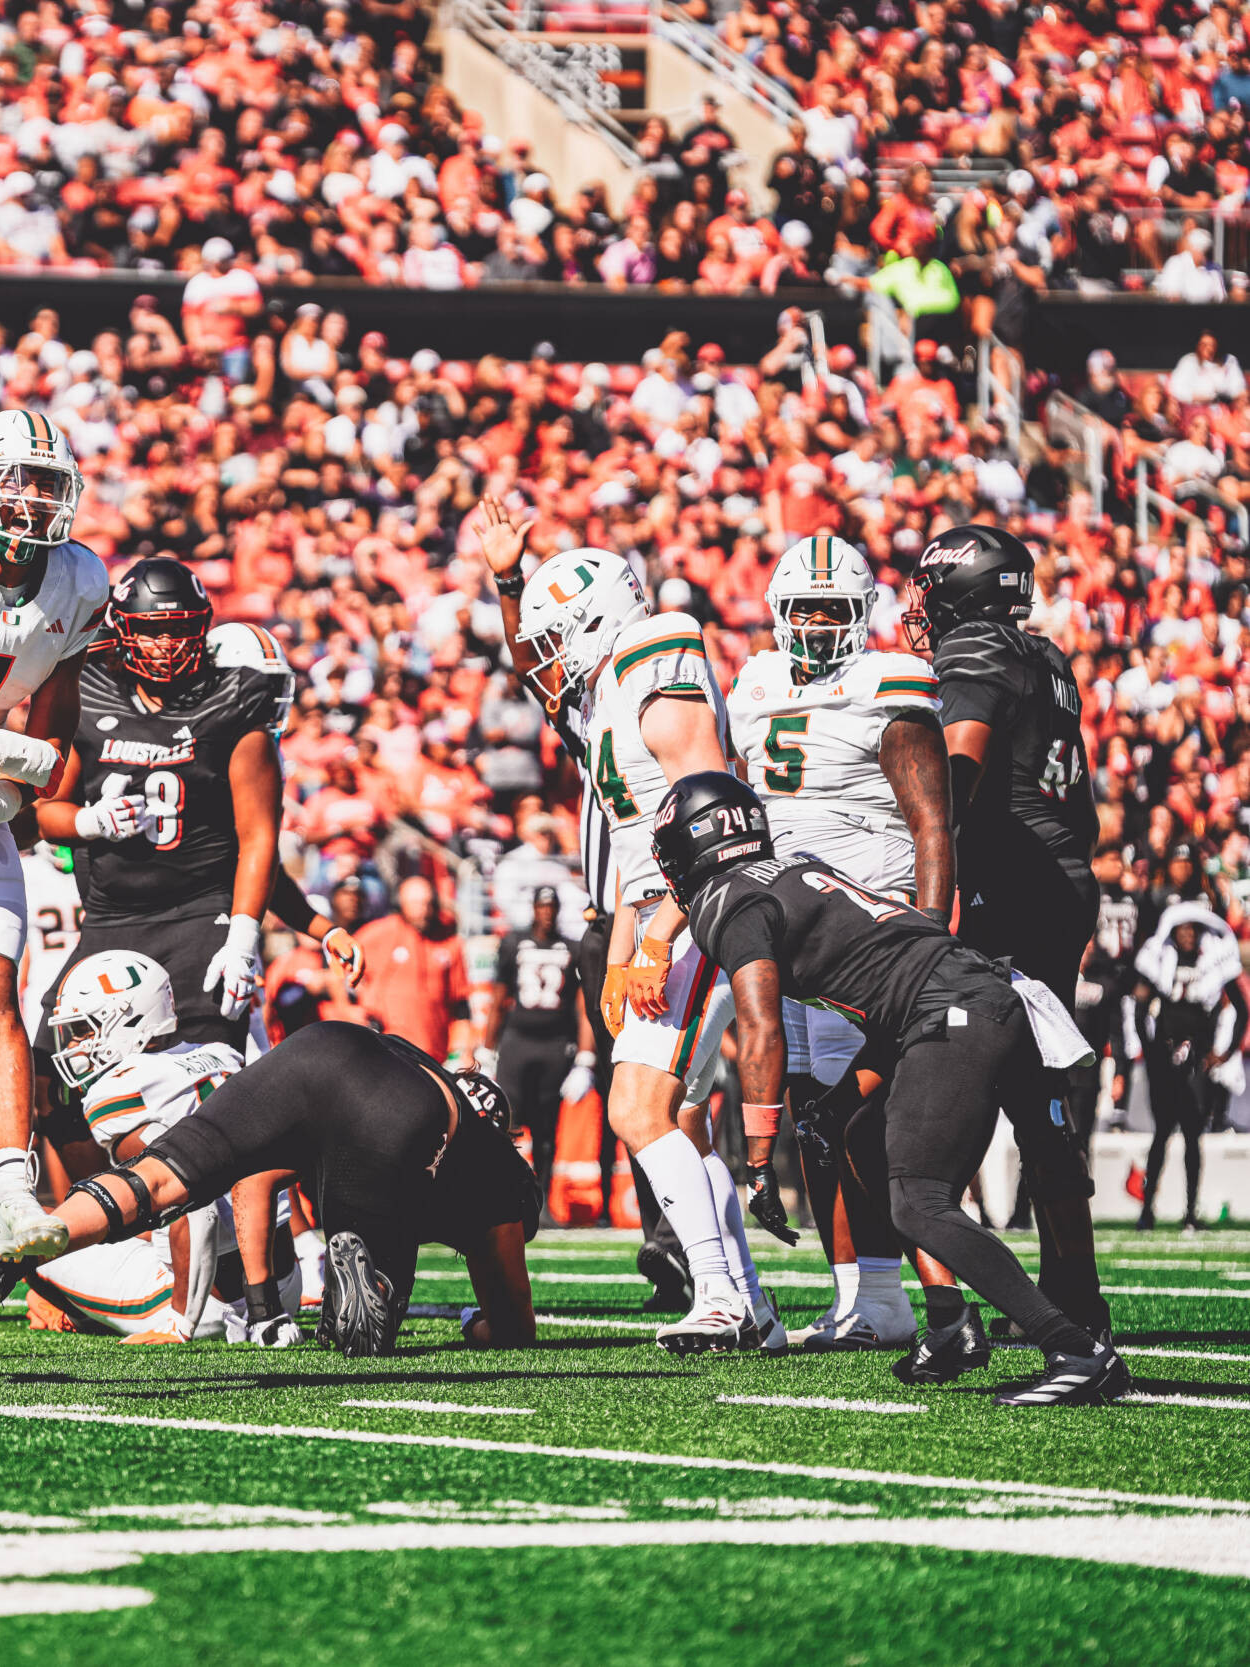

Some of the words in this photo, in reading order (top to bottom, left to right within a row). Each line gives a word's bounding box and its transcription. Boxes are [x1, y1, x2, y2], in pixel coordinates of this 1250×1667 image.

[920, 540, 976, 568] Cards
[99, 738, 196, 768] LOUISVILLE
[764, 713, 810, 797] 5
[716, 806, 748, 837] 24
[718, 840, 762, 863] LOUISVILLE
[477, 1083, 497, 1111] 76
